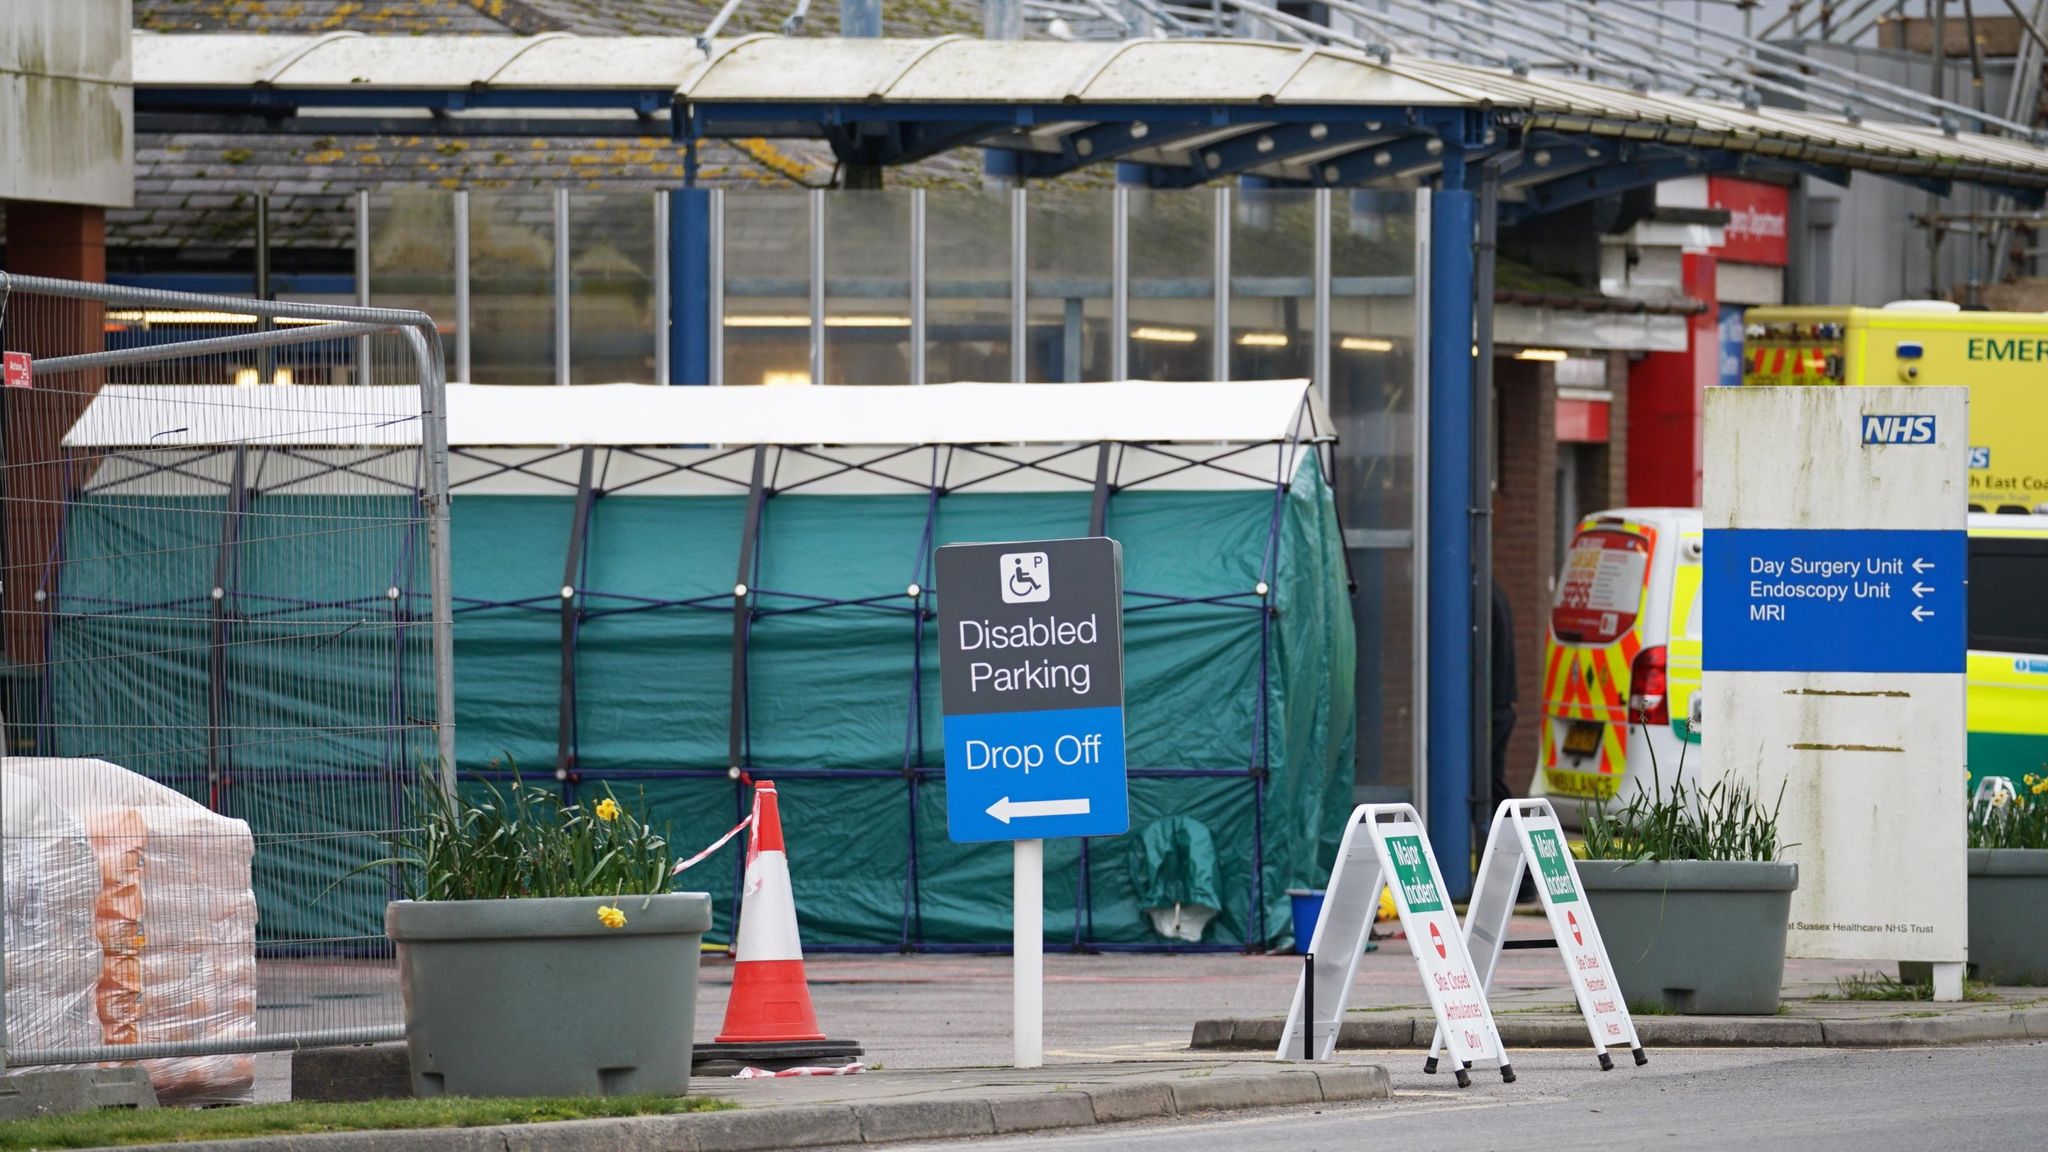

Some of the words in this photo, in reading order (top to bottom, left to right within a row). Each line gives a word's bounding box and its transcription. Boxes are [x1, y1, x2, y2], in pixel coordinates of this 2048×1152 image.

[1967, 337, 2048, 362] EMER
[1864, 416, 1934, 442] NHS
[1986, 475, 2017, 490] East
[2022, 476, 2048, 491] Coa
[1034, 556, 1043, 568] P
[1750, 557, 1785, 578] Day
[1790, 557, 1861, 579] Surgery
[1866, 558, 1904, 575] Unit
[1750, 581, 1848, 602] Endoscopy
[1854, 582, 1891, 599] Unit
[1750, 604, 1785, 622] MRI
[959, 613, 1097, 650] Disabled
[970, 659, 1091, 694] Parking
[966, 740, 1044, 775] Drop
[1054, 733, 1102, 766] Off
[1392, 838, 1421, 872] Major
[1534, 832, 1559, 864] Major
[1401, 876, 1440, 905] Incident
[1543, 868, 1575, 896] Incident
[1796, 921, 1830, 931] Sussex
[1833, 922, 1882, 932] Healthcare
[1885, 923, 1907, 933] NHS
[1911, 924, 1934, 933] Trust
[1584, 954, 1600, 969] Closed
[1434, 971, 1450, 992] Site
[1447, 968, 1471, 990] Closed
[1444, 1000, 1483, 1021] Ambulances
[1464, 1028, 1484, 1054] Only
